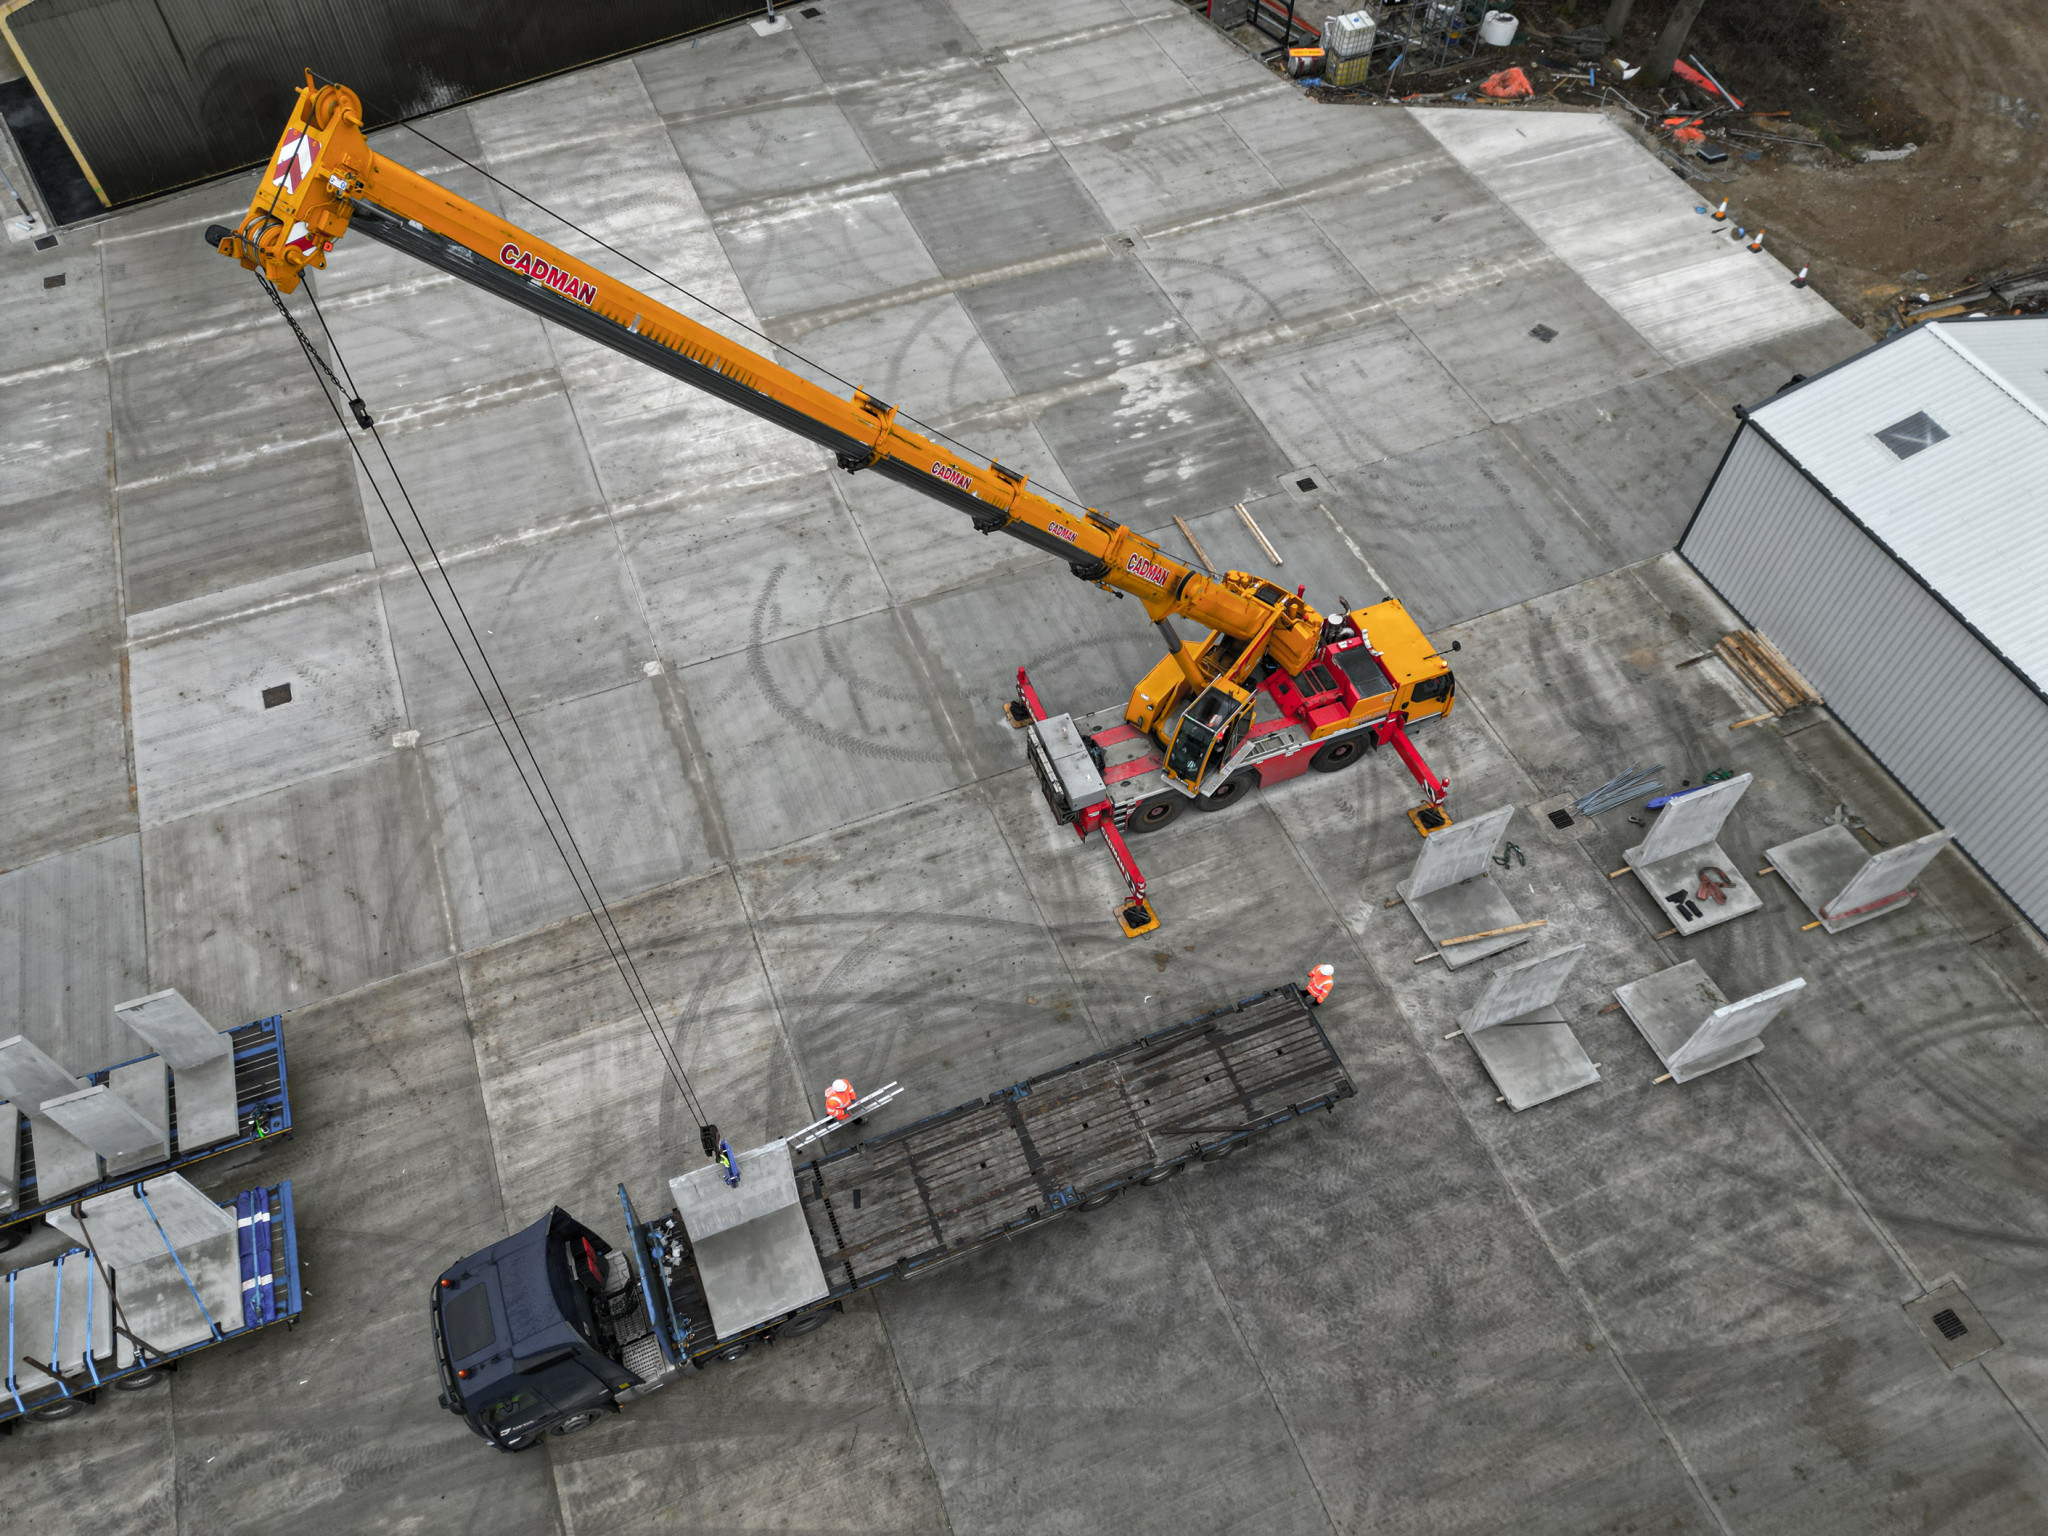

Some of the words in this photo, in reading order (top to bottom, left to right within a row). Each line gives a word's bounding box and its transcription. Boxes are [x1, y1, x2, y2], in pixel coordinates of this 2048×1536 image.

[500, 243, 597, 306] CADMAN
[931, 461, 973, 490] CADMAN
[1048, 521, 1078, 543] CADMAN
[1127, 552, 1170, 587] CADMAN
